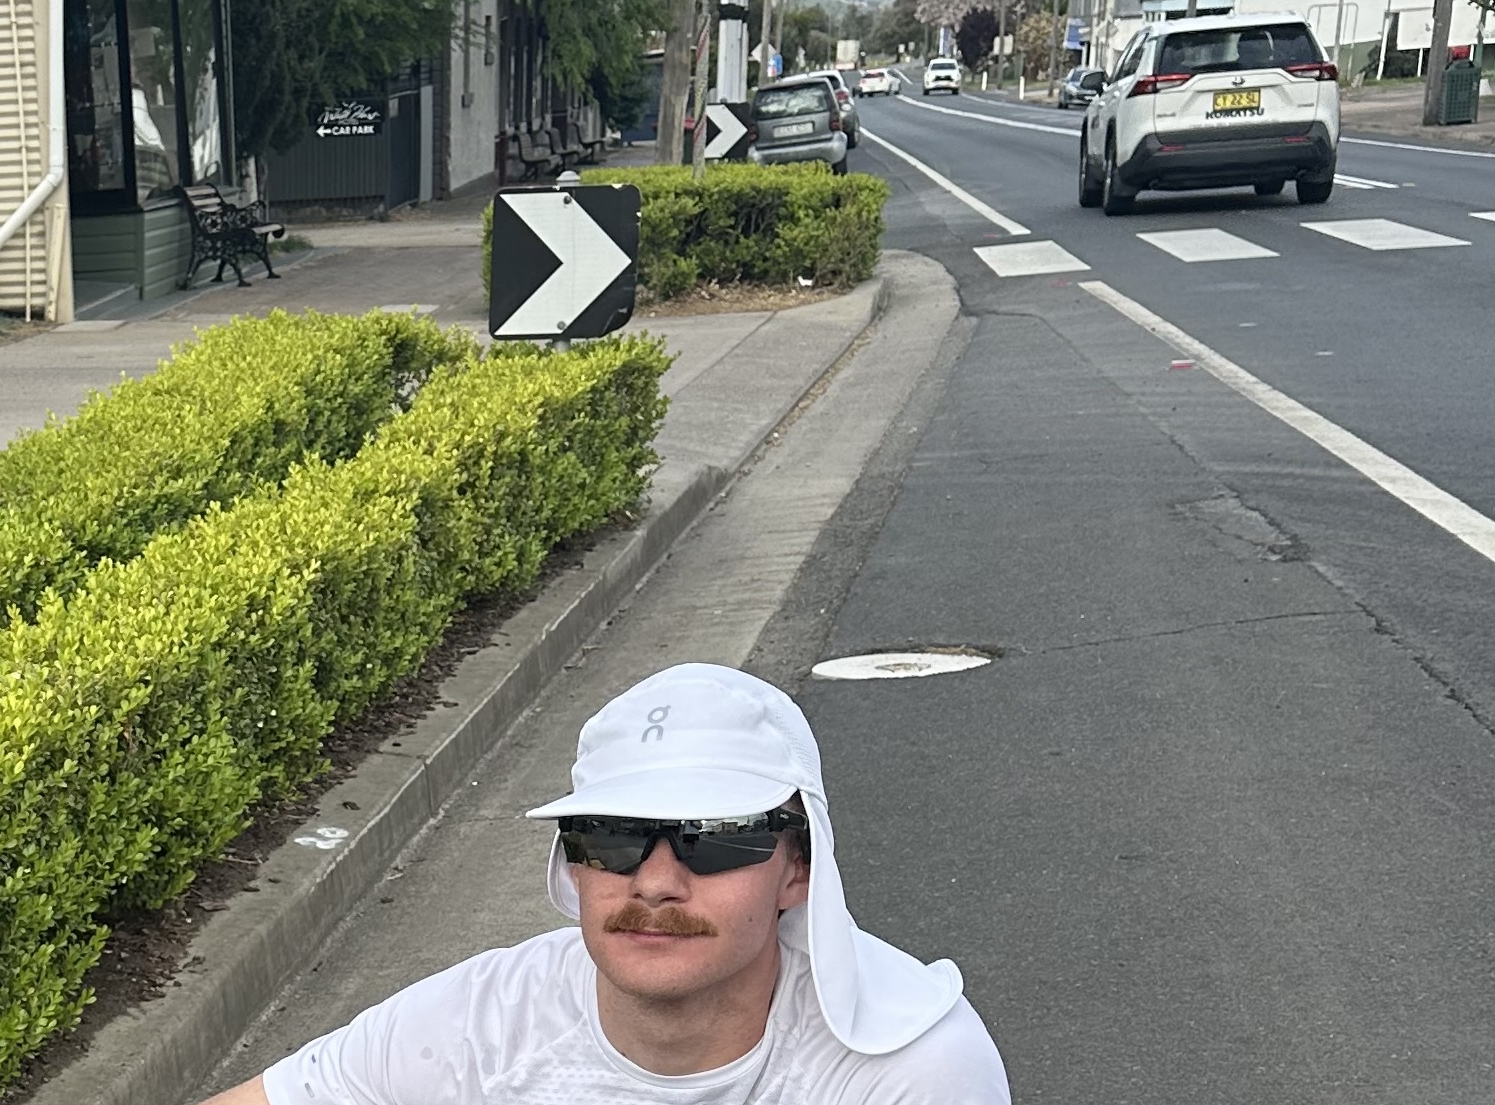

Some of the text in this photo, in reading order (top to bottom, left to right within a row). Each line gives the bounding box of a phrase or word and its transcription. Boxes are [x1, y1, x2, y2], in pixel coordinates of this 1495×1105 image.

[1205, 108, 1264, 119] KOMATSU
[331, 125, 375, 135] CAR PARK
